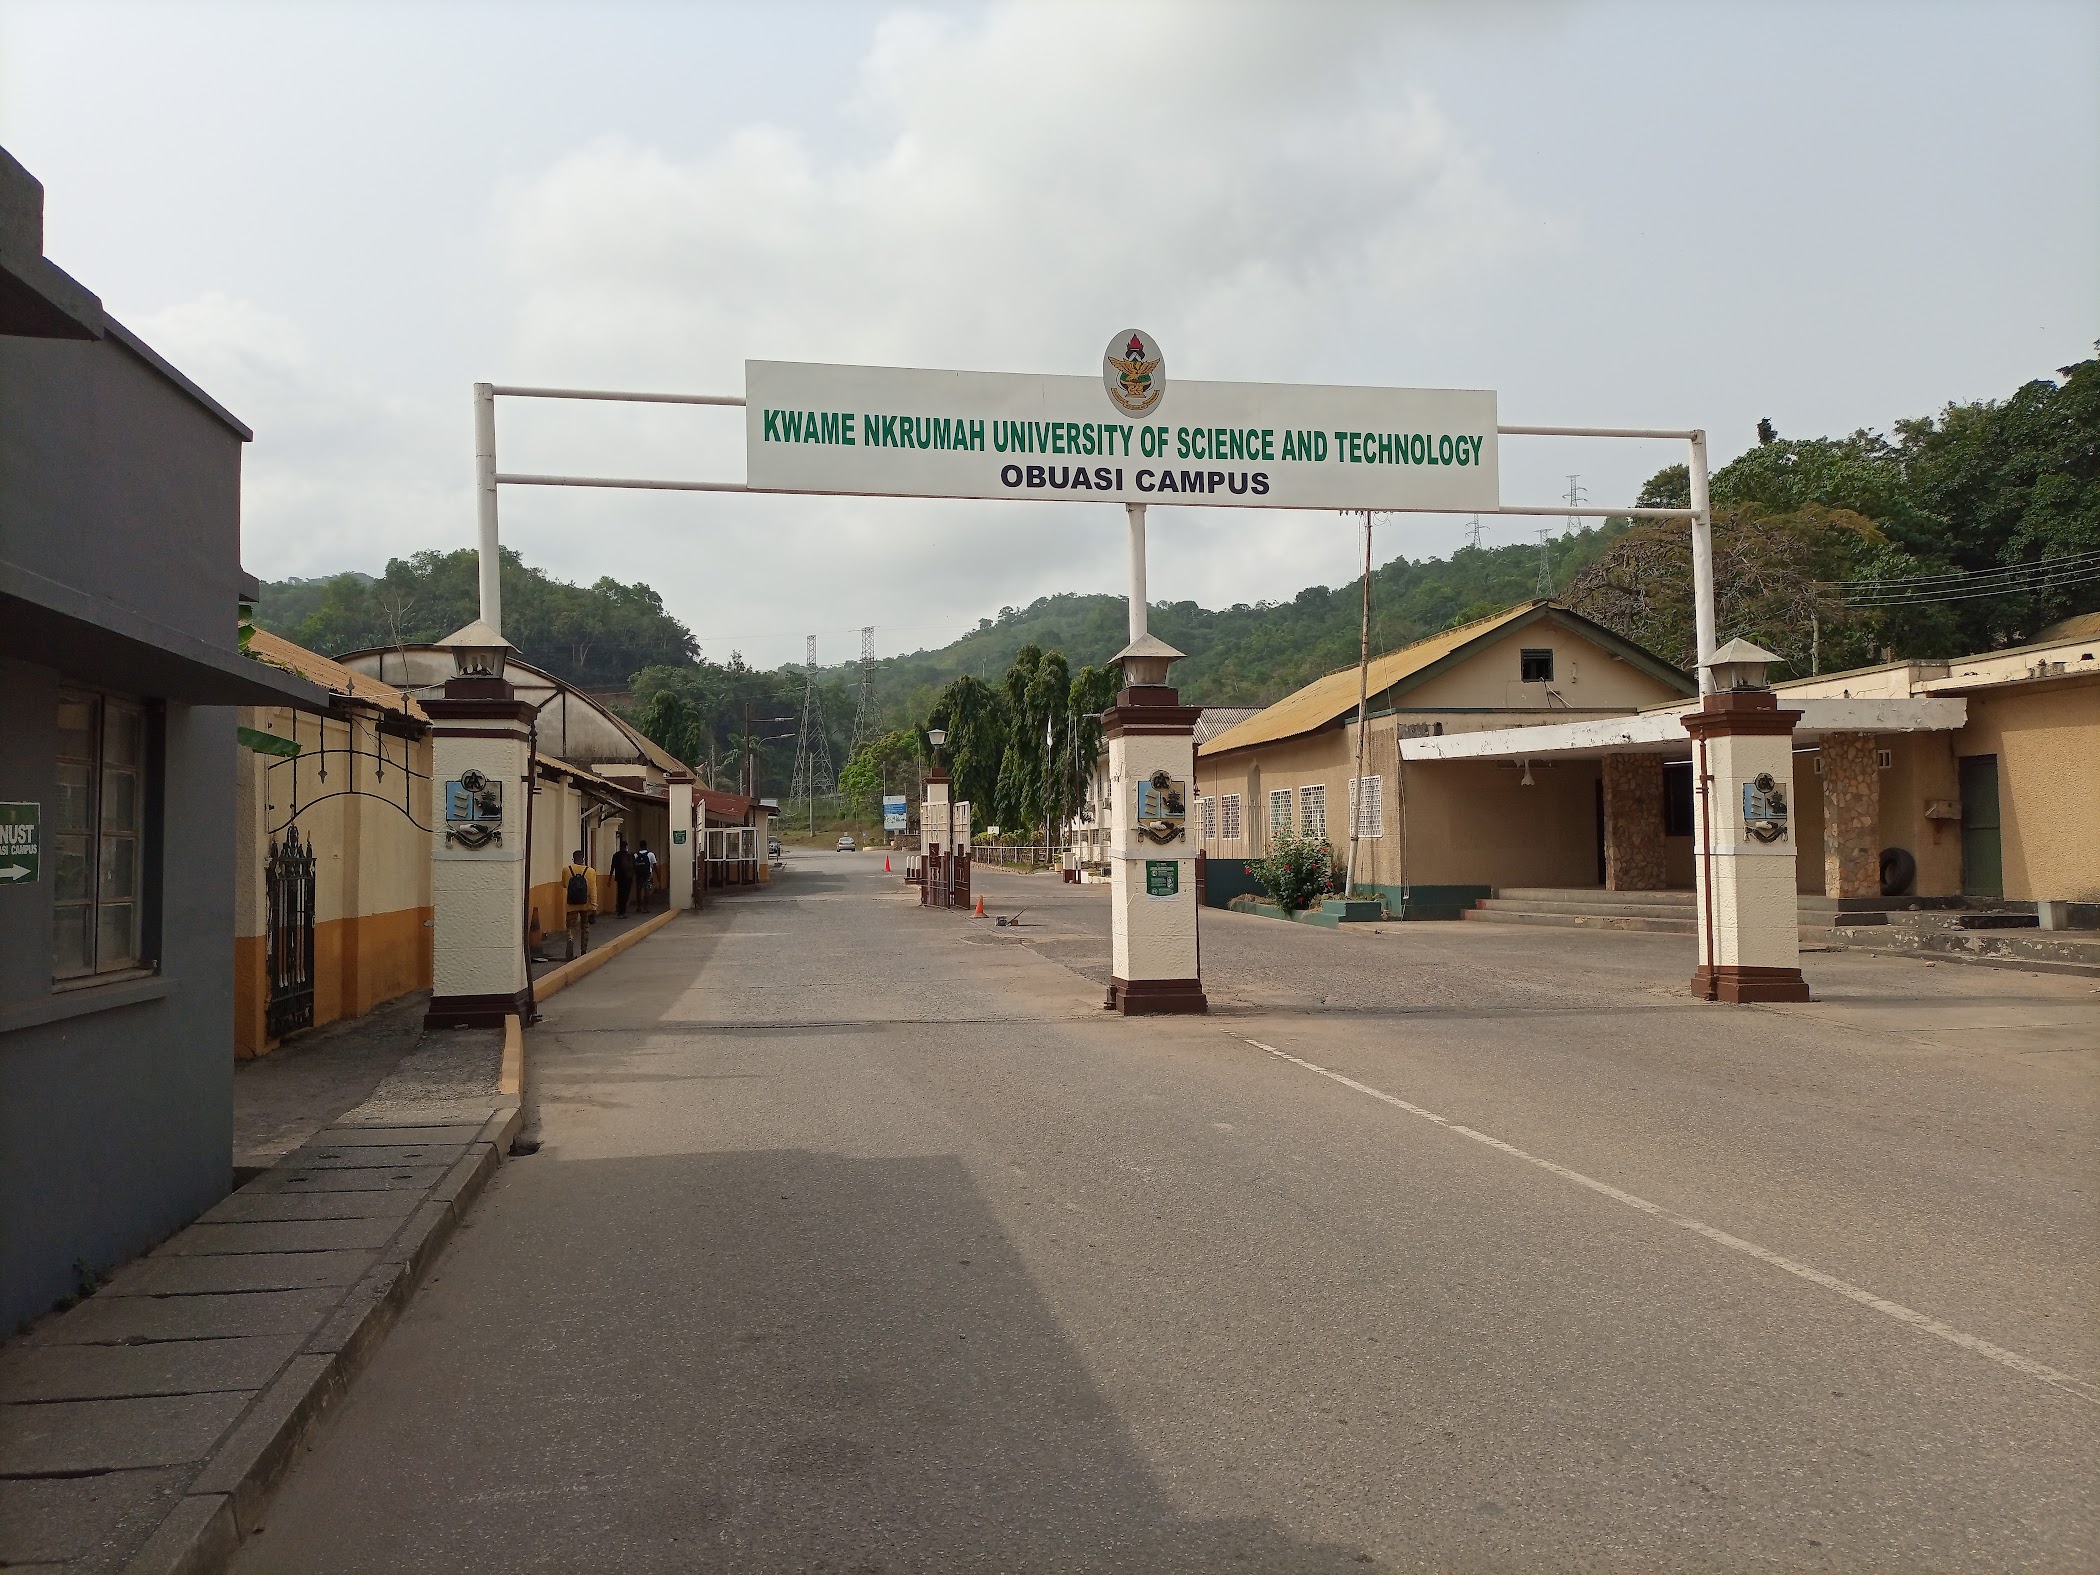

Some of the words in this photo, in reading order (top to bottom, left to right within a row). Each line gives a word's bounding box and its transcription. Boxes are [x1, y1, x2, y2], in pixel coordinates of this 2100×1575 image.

[763, 409, 856, 446] KWAME
[863, 414, 985, 452] NKRUMAH
[992, 420, 1133, 457] UNIVERSITY
[1140, 425, 1169, 458] OF
[1177, 427, 1276, 461] SCIENCE
[1281, 430, 1328, 462] AND
[1335, 431, 1483, 466] TECHNOLOGY
[1000, 464, 1123, 491] OBUASI
[1135, 469, 1270, 495] CAMPUS
[11, 844, 37, 855] CAMPUS
